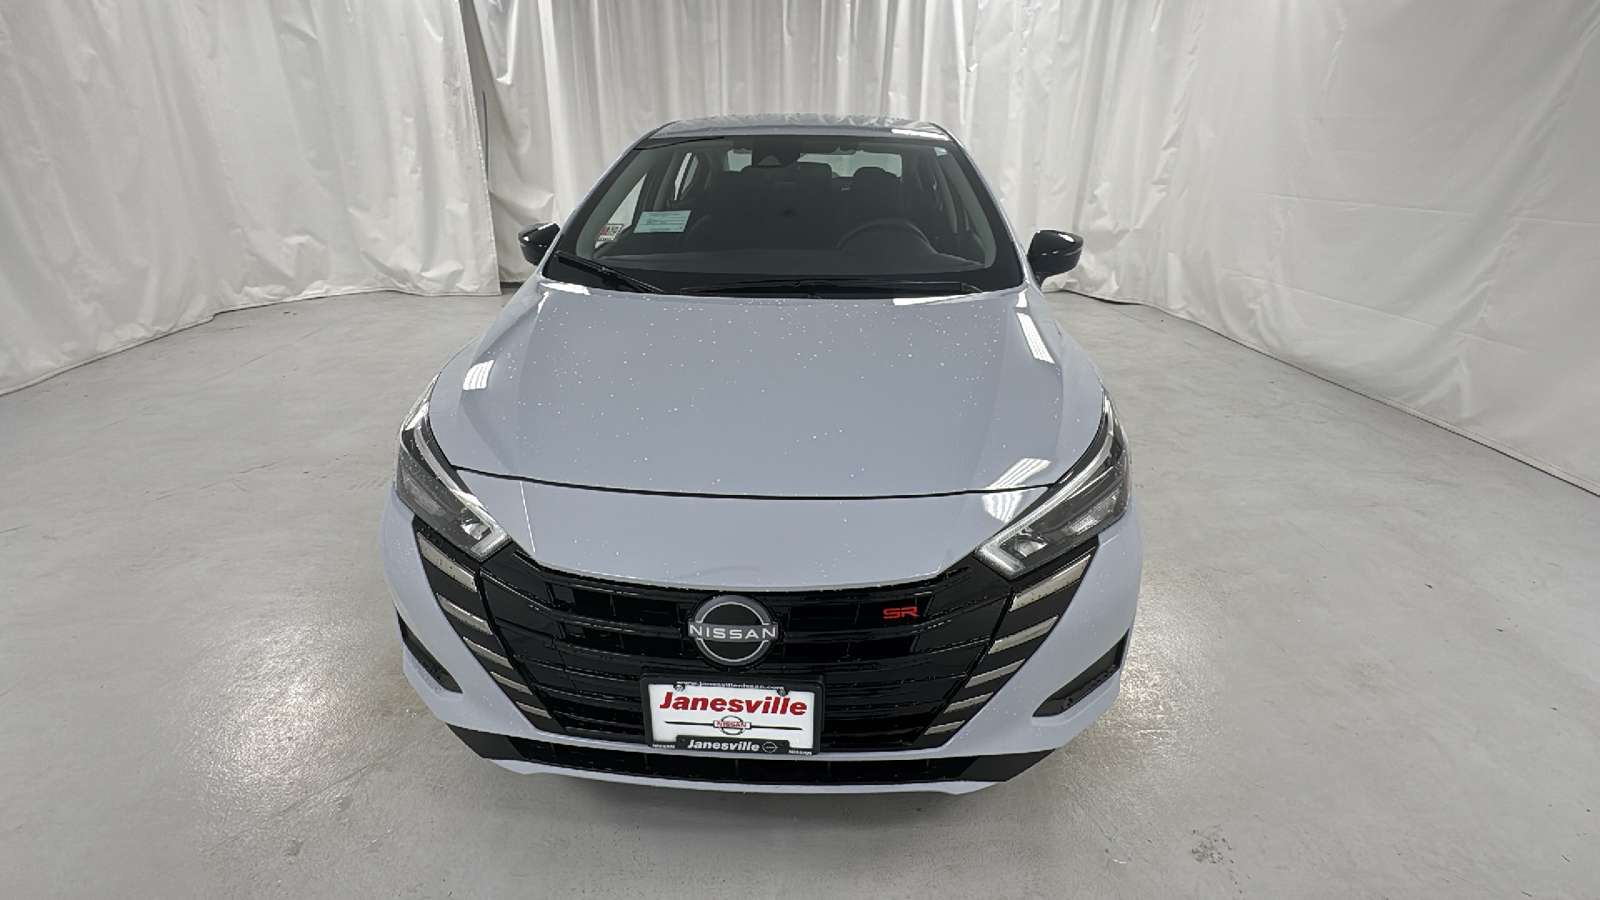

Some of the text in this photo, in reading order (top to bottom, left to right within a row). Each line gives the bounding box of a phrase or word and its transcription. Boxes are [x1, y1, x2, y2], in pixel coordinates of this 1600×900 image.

[882, 606, 919, 619] SR
[689, 624, 777, 639] NISSAN
[659, 691, 807, 716] Janesville
[687, 739, 760, 751] Janesville
